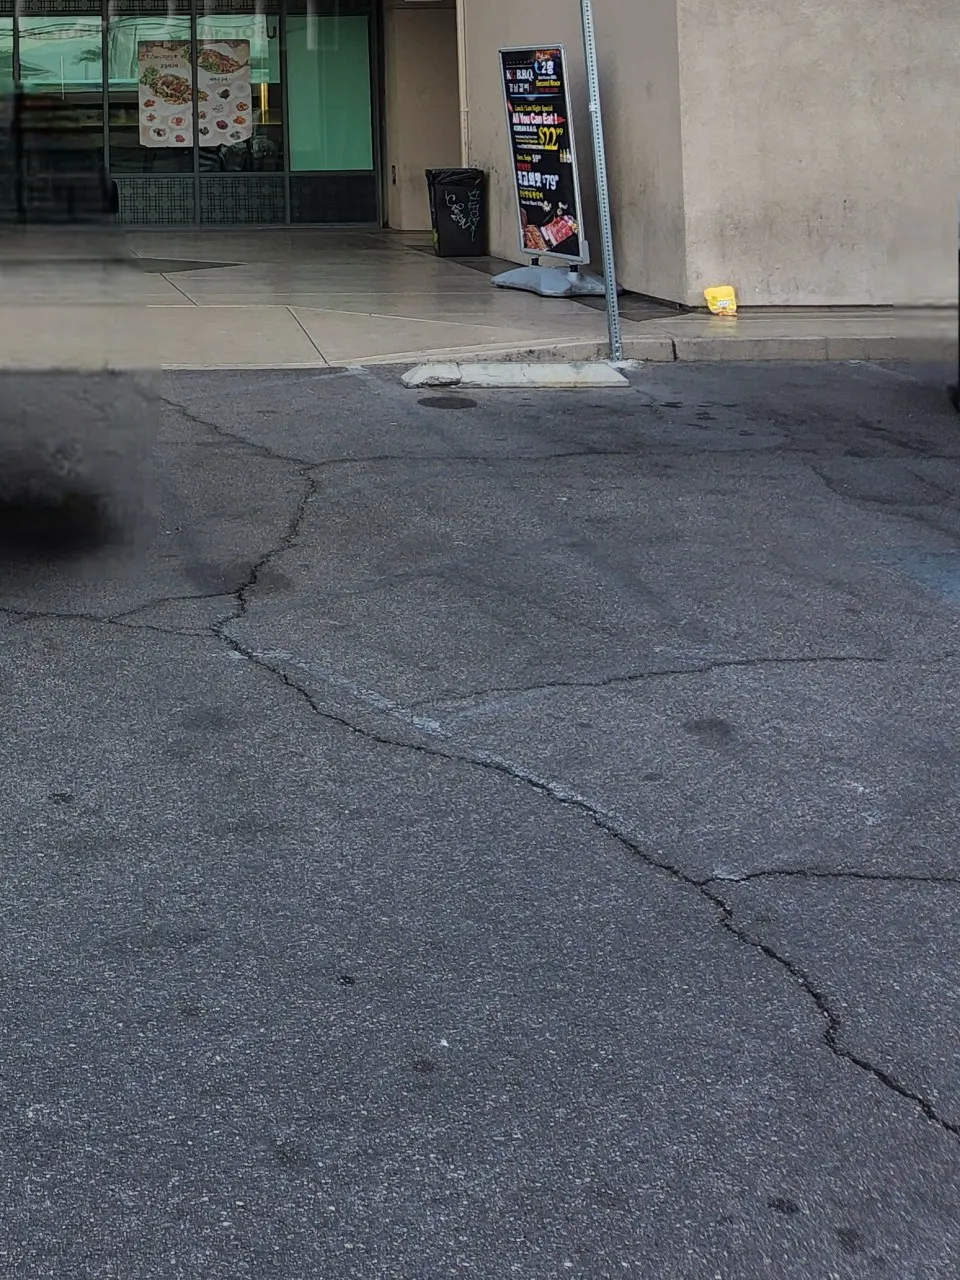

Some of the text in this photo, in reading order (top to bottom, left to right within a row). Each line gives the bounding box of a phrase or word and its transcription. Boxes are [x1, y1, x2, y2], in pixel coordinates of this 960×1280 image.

[519, 112, 531, 124] You
[530, 112, 542, 125] Can
[542, 112, 554, 125] Eat
